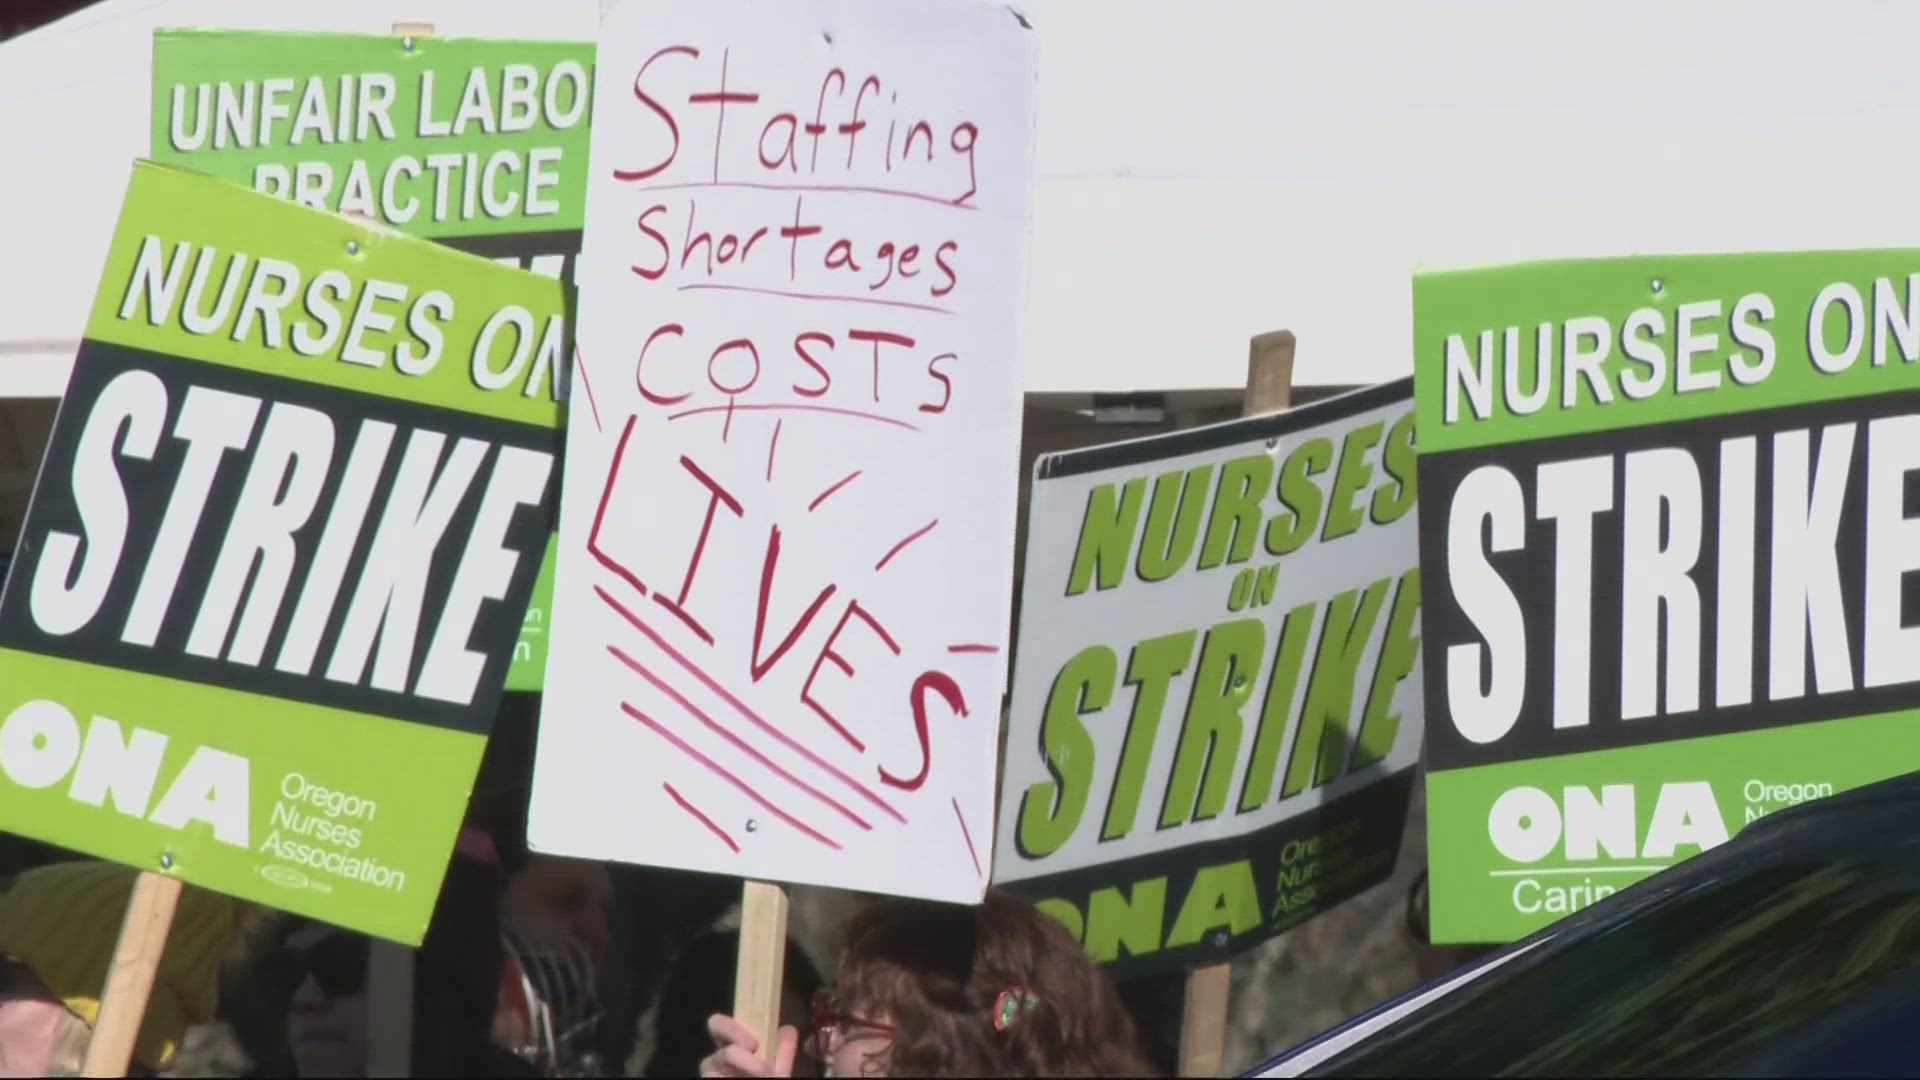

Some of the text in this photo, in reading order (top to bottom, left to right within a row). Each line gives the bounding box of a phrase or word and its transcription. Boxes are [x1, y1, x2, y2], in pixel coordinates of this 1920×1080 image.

[169, 60, 594, 151] UNFAIR LABO
[613, 46, 979, 205] Staffing
[254, 147, 563, 227] PRACTICE
[631, 193, 958, 296] Shortages
[117, 235, 455, 377] NURSES
[1442, 272, 1920, 426] NURSES ON
[30, 369, 555, 706] STRIKE
[1065, 410, 1416, 597] NURSES
[588, 414, 969, 791] LIVES
[1227, 562, 1281, 613] ON
[1447, 414, 1920, 744] STRIKE
[1015, 567, 1422, 860] STRIKE
[0, 699, 249, 849] ONA
[270, 801, 362, 848] Nurses
[281, 773, 376, 821] Oregon
[1488, 781, 1730, 862] ONA
[1744, 779, 1833, 805] Oregon
[259, 830, 405, 891] Association
[1512, 877, 1617, 913] Carin
